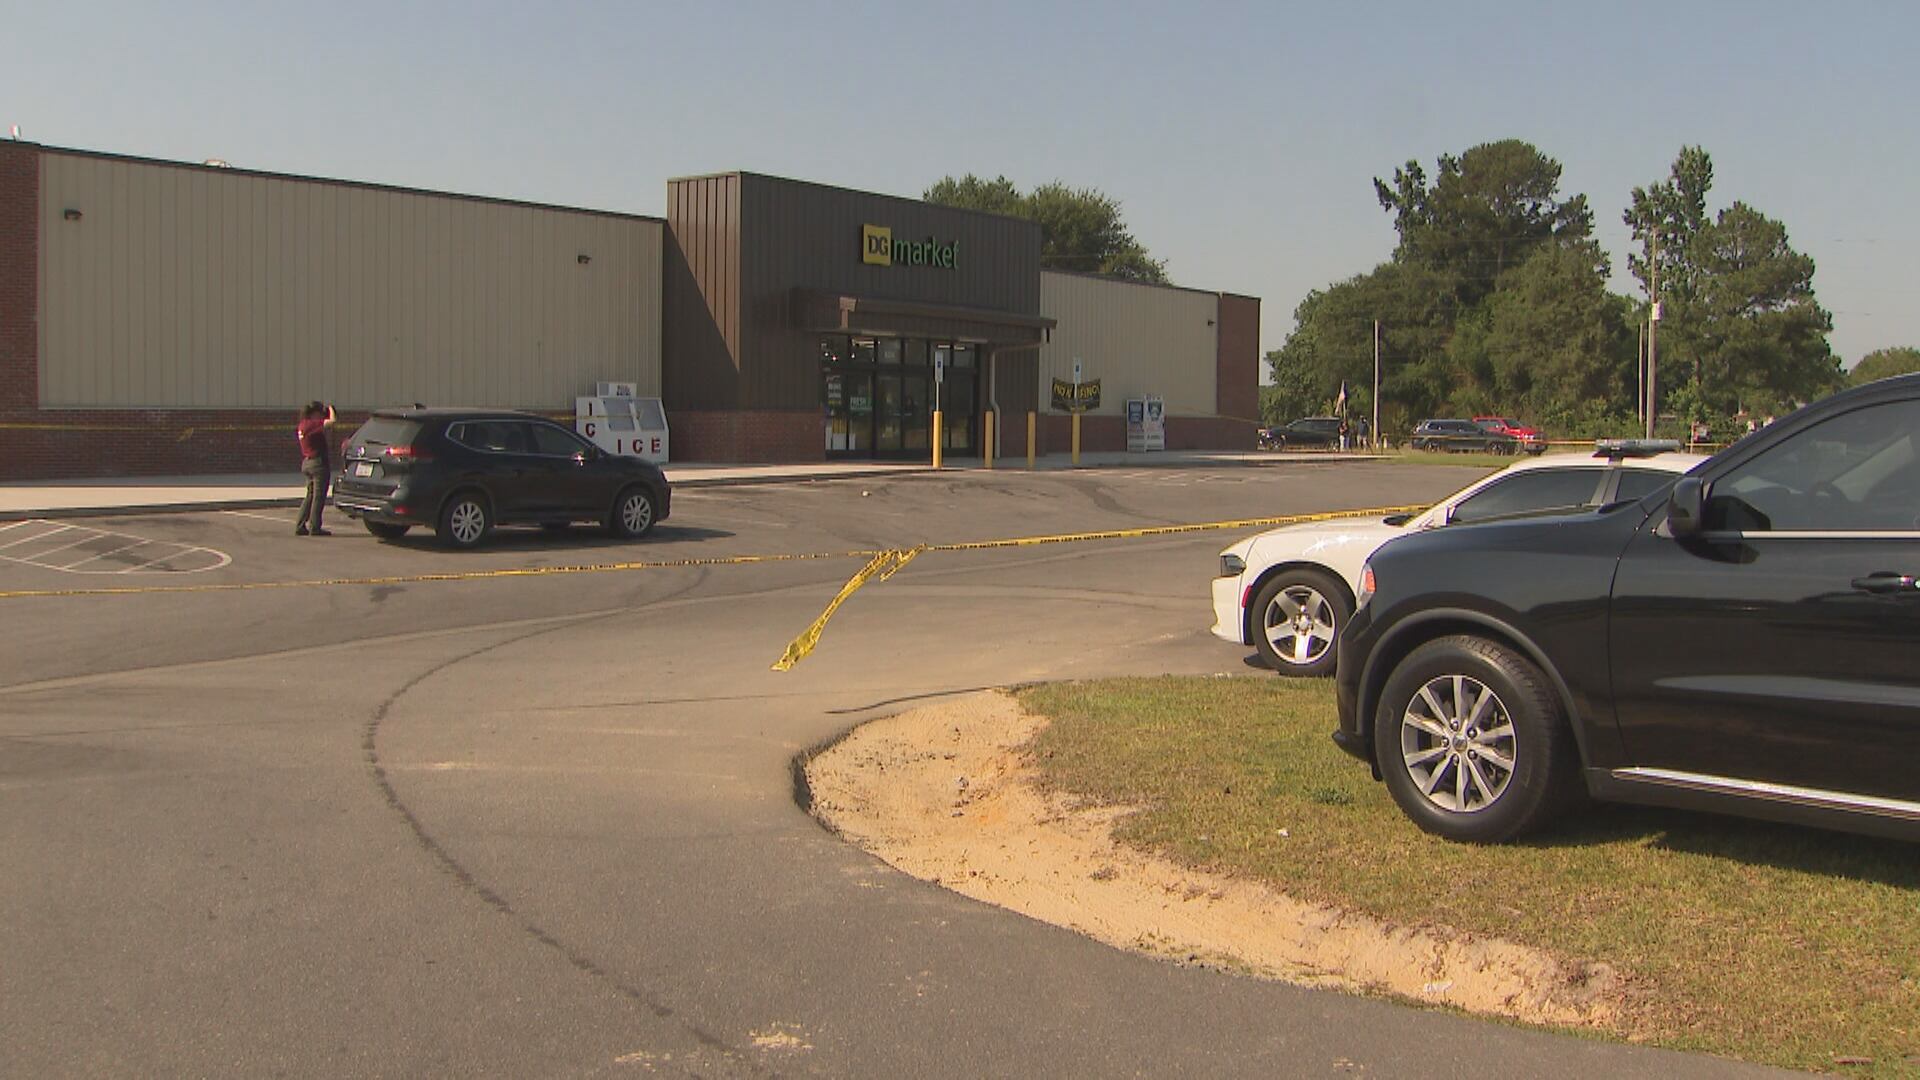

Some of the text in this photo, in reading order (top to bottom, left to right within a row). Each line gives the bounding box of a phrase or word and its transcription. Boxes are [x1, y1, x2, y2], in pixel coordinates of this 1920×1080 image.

[867, 234, 960, 271] DG market
[617, 438, 661, 454] ICE
